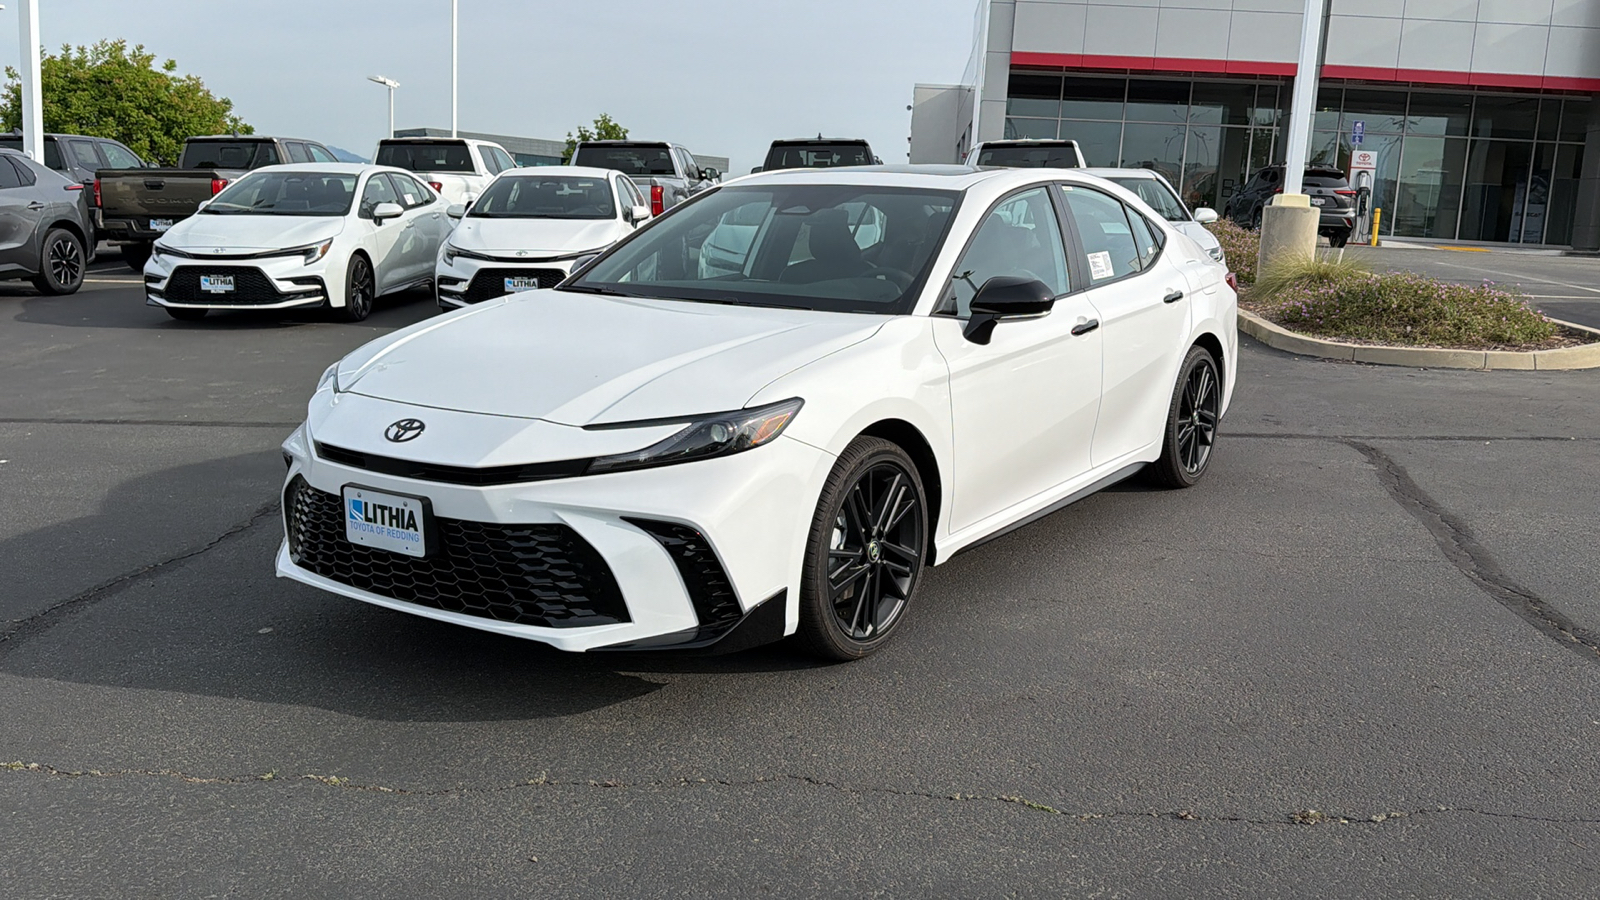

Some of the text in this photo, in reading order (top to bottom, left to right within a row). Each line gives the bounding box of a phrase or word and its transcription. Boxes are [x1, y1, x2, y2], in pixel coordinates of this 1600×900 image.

[209, 278, 233, 286] LITHIA
[363, 501, 418, 532] LITHIA
[349, 520, 419, 543] TOYOTA OF REDDING
